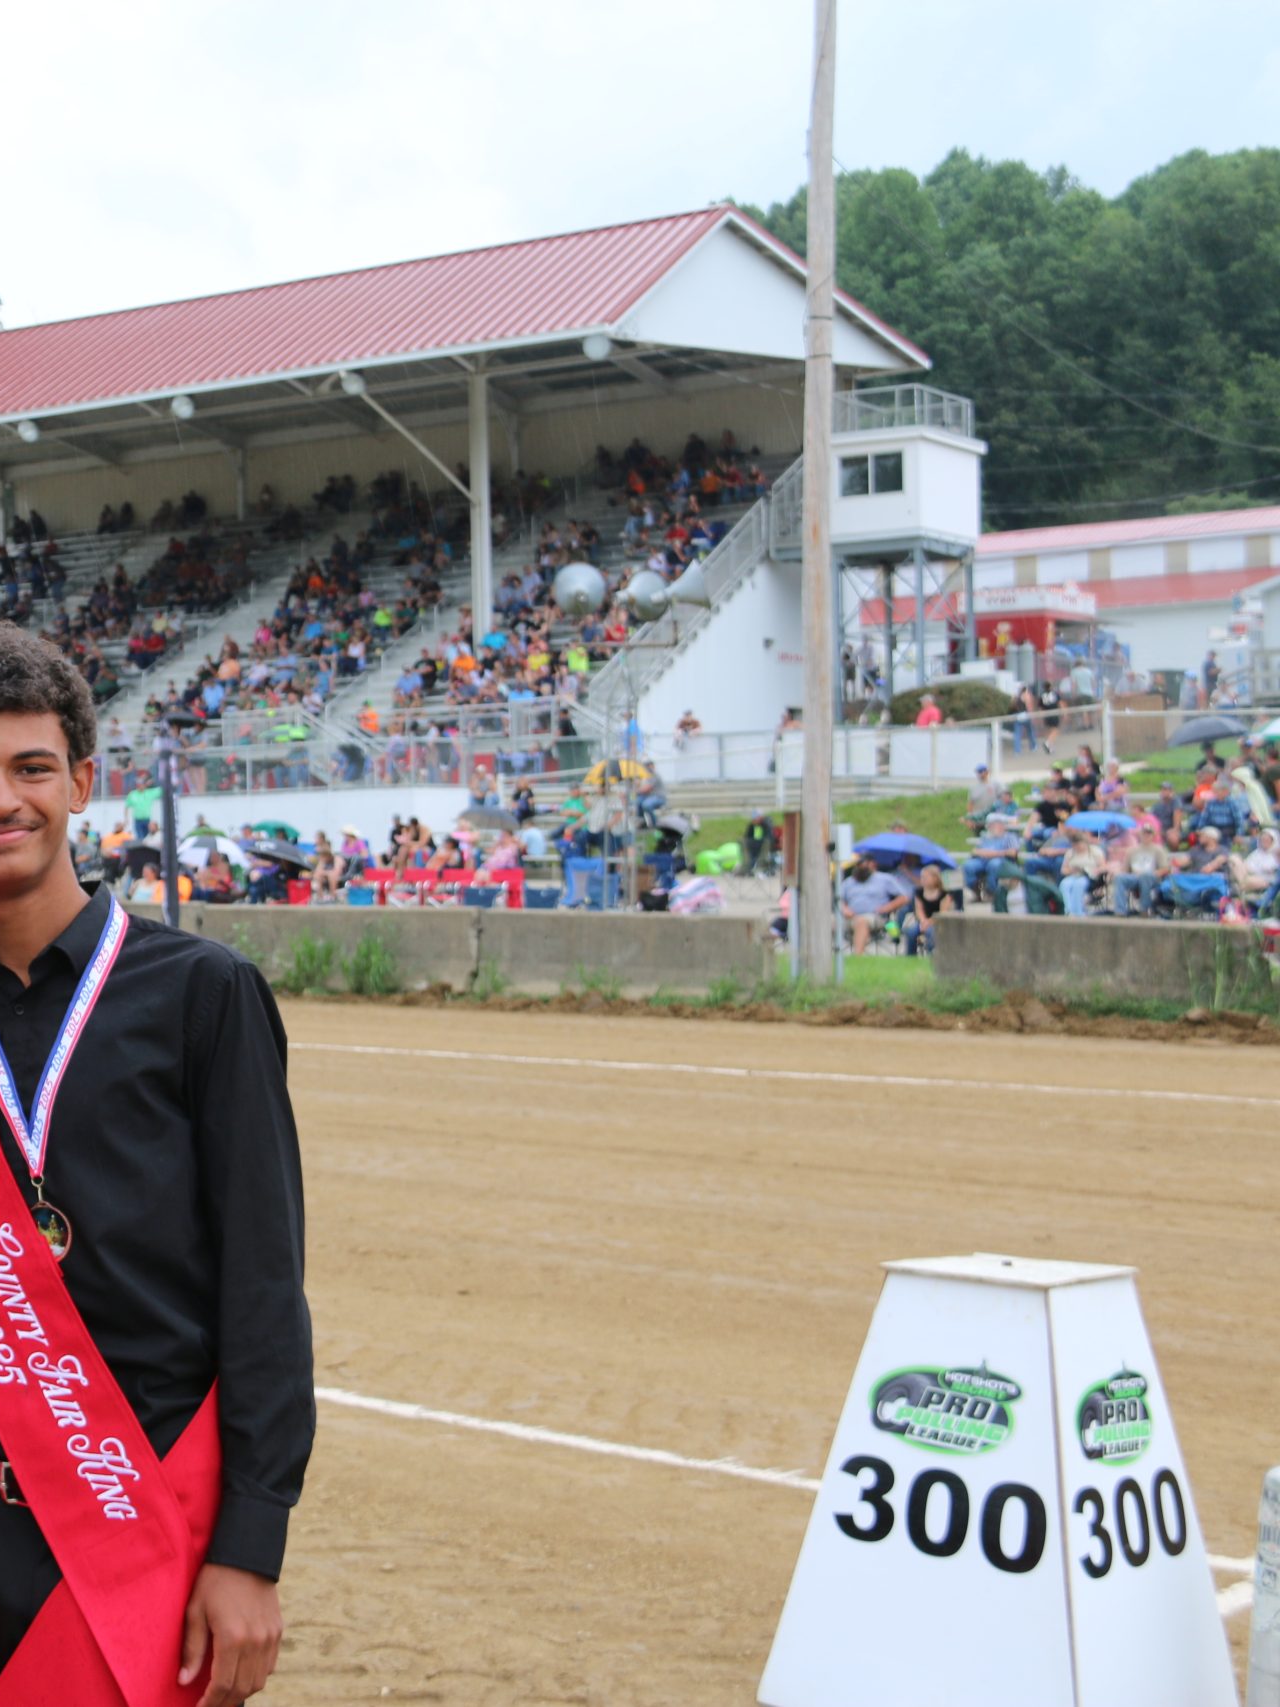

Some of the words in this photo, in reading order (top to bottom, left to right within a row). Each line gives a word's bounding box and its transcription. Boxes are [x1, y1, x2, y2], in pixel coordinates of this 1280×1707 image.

[919, 1388, 994, 1421] PRO
[1103, 1399, 1139, 1425] PRO
[27, 1351, 89, 1428] FAIR
[66, 1433, 141, 1520] KING
[895, 1405, 1008, 1442] PULLING
[905, 1424, 979, 1450] LEAGUE
[1103, 1440, 1140, 1456] LEAGUE
[832, 1453, 1047, 1574] 300
[1072, 1466, 1187, 1579] 300
